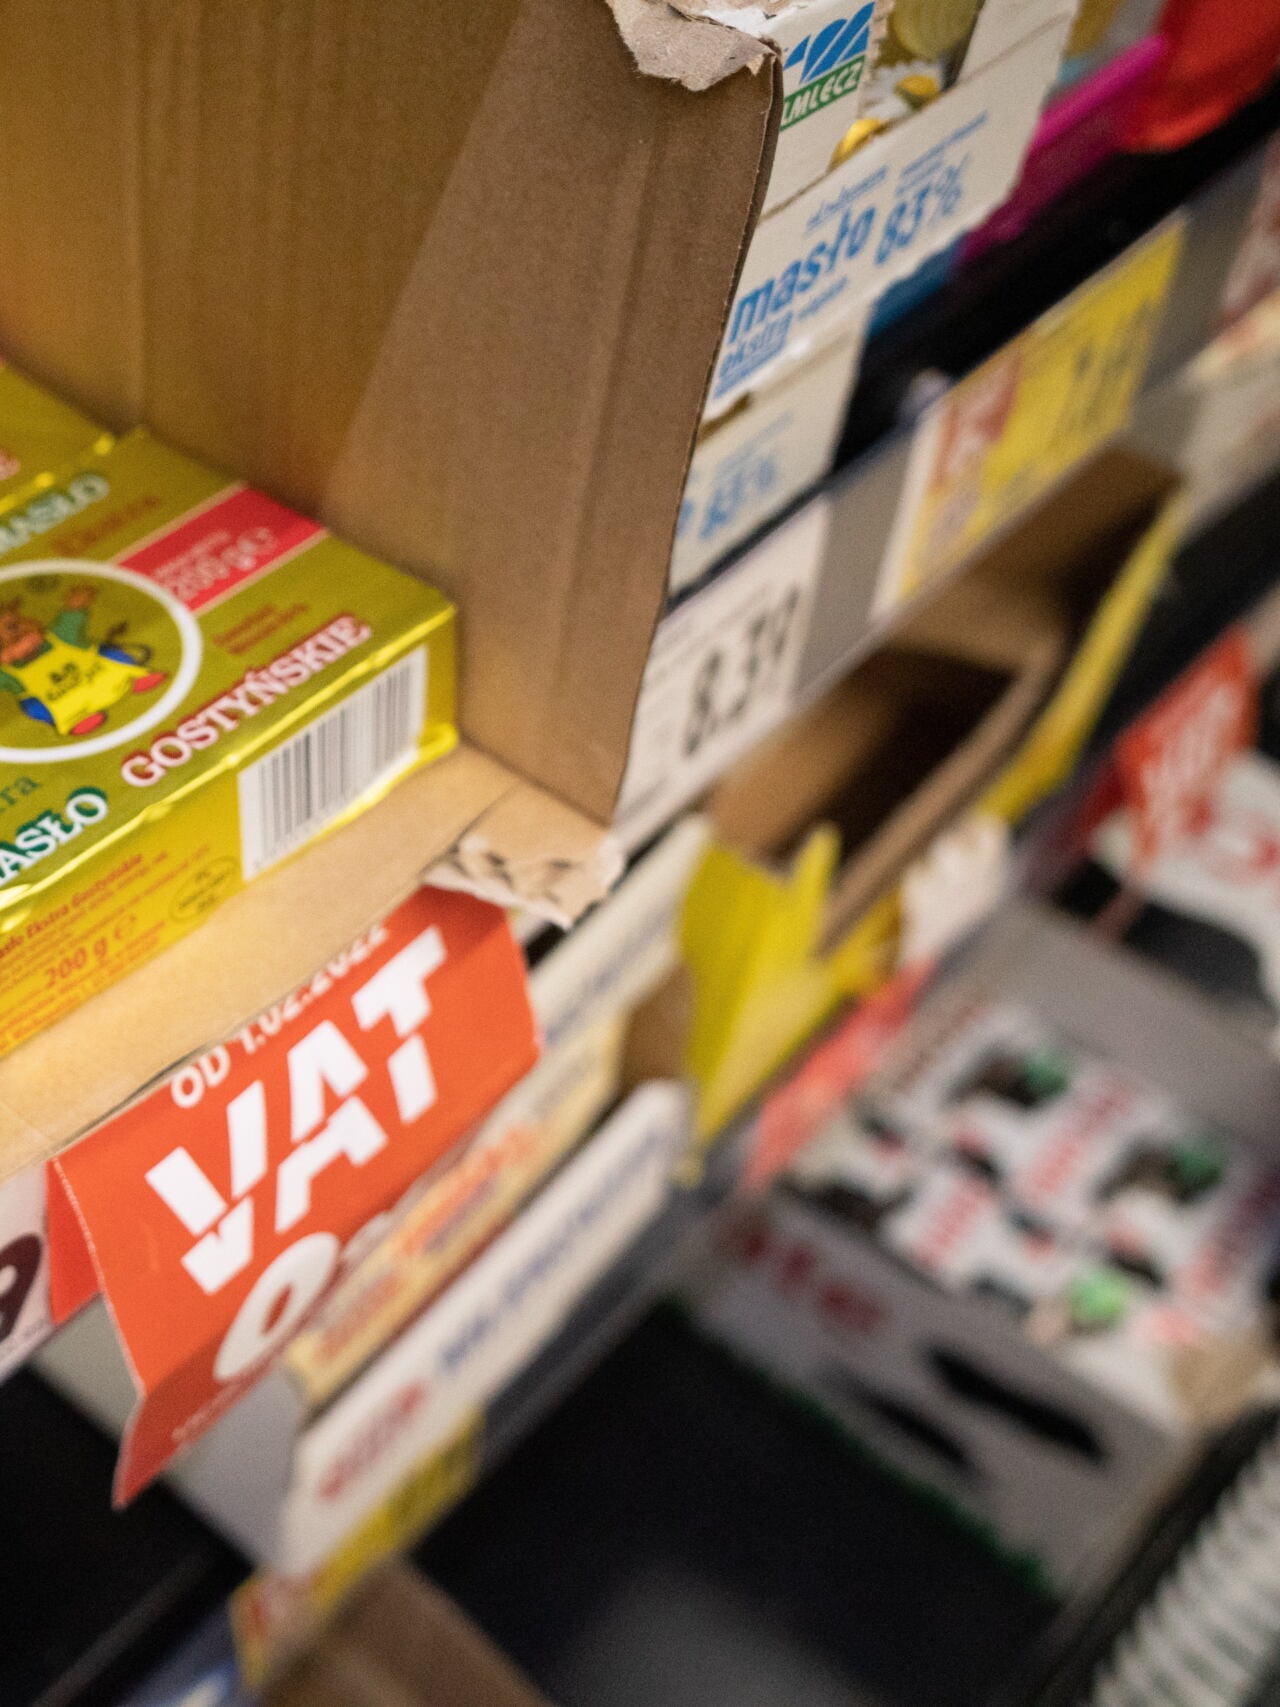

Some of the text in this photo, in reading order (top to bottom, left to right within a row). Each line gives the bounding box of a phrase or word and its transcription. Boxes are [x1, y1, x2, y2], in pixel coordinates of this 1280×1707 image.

[729, 207, 876, 344] masło
[121, 612, 373, 787] GOSTYŃSKIE
[144, 925, 448, 1296] VAT
[170, 1042, 232, 1109] OD
